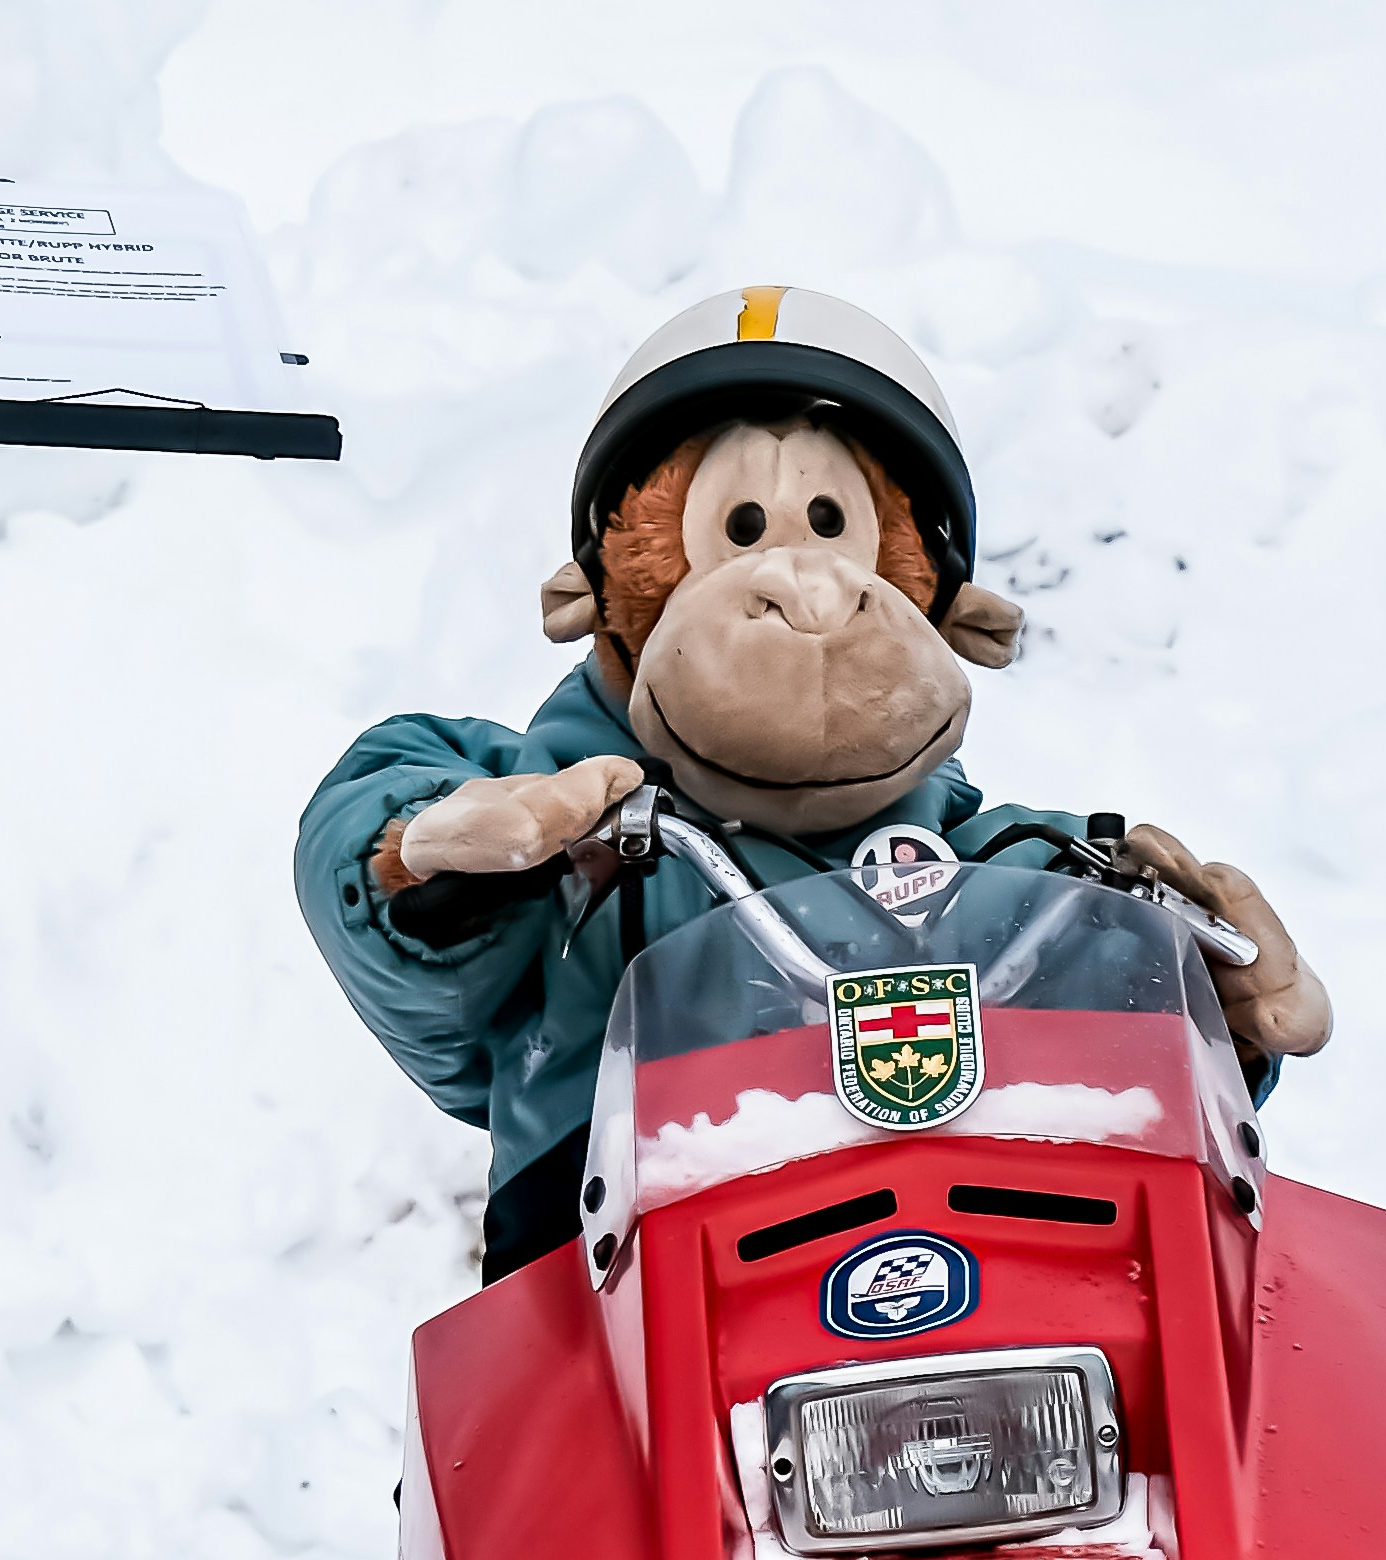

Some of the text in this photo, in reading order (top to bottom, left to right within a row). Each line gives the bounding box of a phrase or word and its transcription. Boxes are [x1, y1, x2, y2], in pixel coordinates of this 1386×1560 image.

[20, 208, 86, 220] SERVICE
[88, 242, 154, 252] HYBRID
[28, 254, 85, 265] BRUTE
[876, 869, 945, 906] RUPP
[837, 996, 977, 1123] ONTARIO FEDERATION OF SNOWMOBILE CLUBS
[871, 1276, 923, 1294] OSAF
